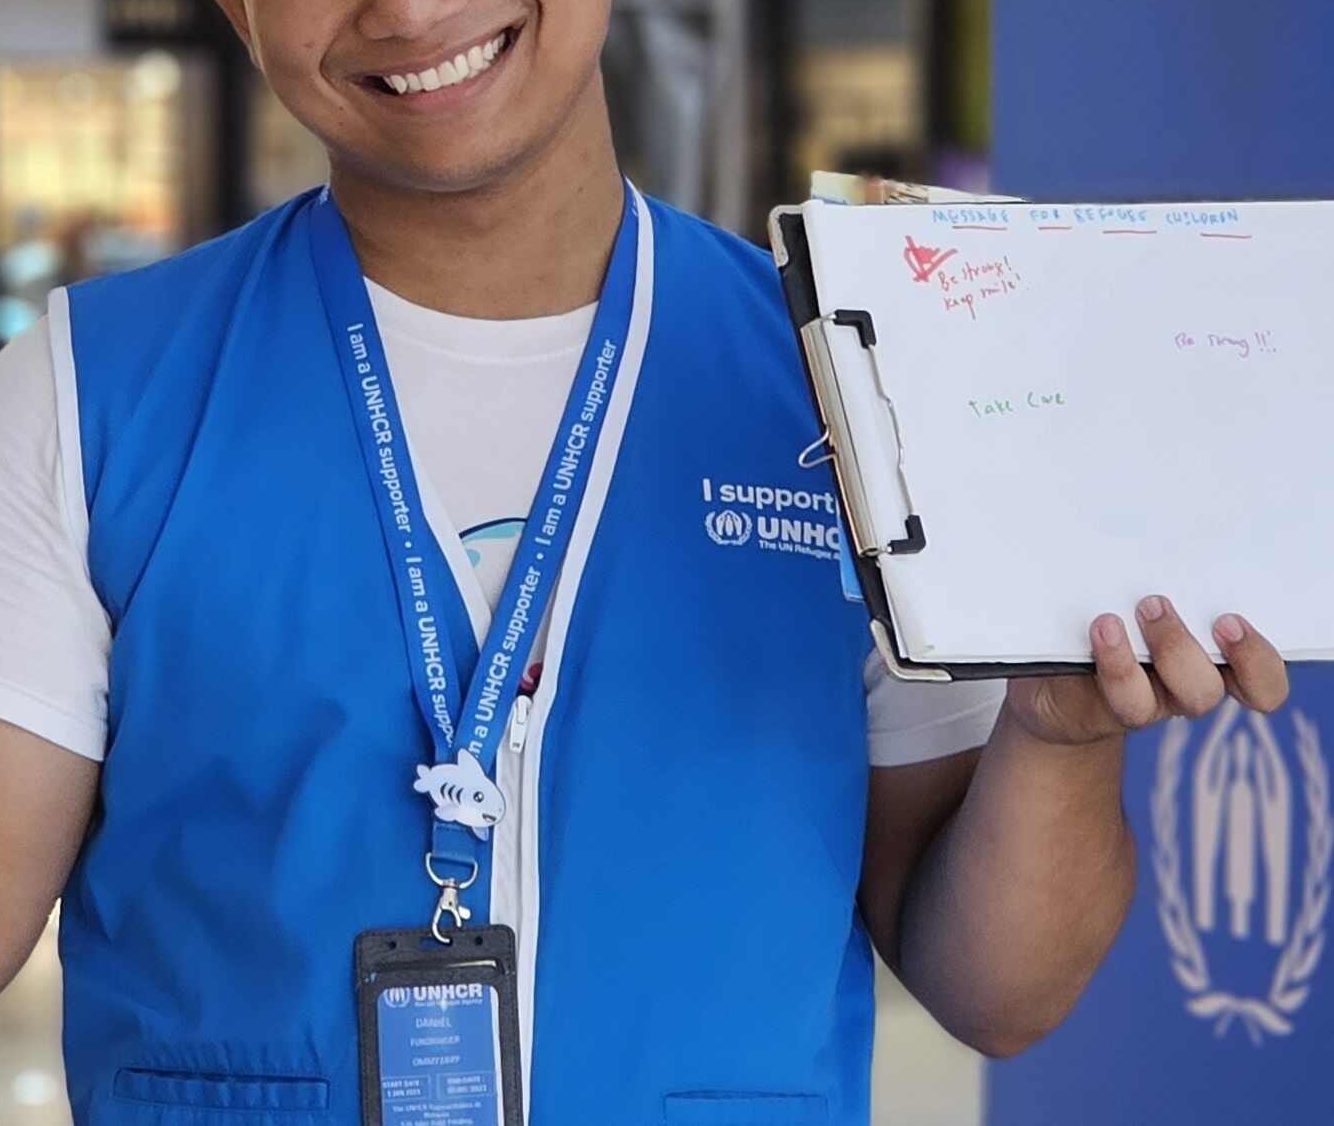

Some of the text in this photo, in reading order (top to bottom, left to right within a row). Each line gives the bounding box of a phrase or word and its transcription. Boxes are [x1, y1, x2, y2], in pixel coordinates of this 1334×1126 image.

[932, 208, 1009, 224] MESSAGE
[1029, 208, 1060, 221] FOR
[1166, 208, 1239, 225] CHILDREN
[346, 322, 364, 332] I
[350, 333, 368, 360] am
[357, 363, 371, 374] a
[581, 339, 617, 422] supporter
[361, 376, 393, 444] UNHCR
[553, 424, 590, 491] UNHCR
[379, 446, 412, 533] supporter
[553, 493, 567, 505] a
[702, 478, 835, 514] I support
[542, 508, 563, 537] am
[535, 536, 552, 547] I
[758, 539, 776, 550] The
[778, 541, 793, 552] UN
[405, 556, 422, 565] I
[408, 567, 425, 596] am
[415, 600, 428, 612] a
[502, 566, 541, 652] supporter
[418, 617, 446, 691] UNHCR
[475, 652, 512, 722] UNHCR
[474, 726, 488, 739] a
[413, 983, 483, 1001] UNHCR
